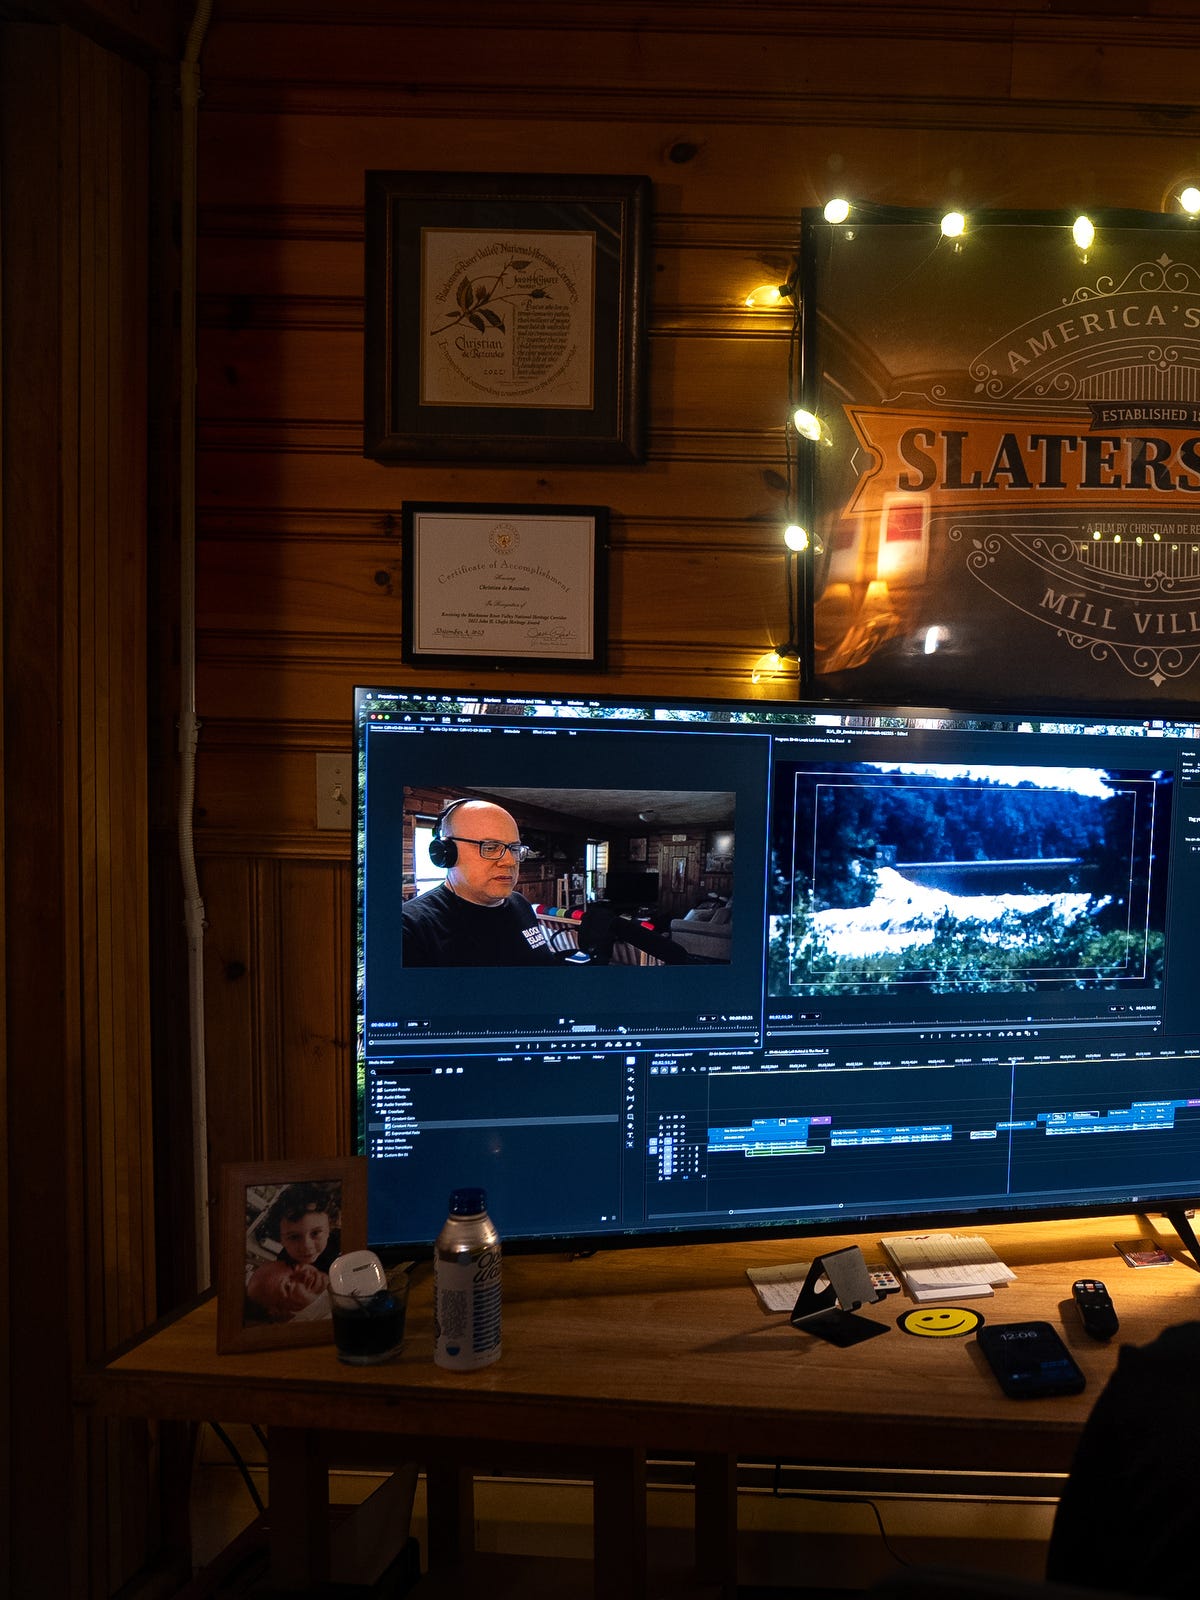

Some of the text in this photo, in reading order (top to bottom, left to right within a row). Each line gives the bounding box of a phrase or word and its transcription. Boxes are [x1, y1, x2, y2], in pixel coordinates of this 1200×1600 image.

[455, 335, 503, 351] Christian
[1006, 303, 1200, 374] AMERICA'S
[1102, 408, 1187, 422] ESTABLISHED
[1095, 523, 1115, 535] FILM
[1116, 524, 1128, 534] BY
[1129, 524, 1175, 535] CHRISTIAN
[1177, 525, 1188, 535] DE
[438, 560, 570, 593] Certificate of Accomplishment
[1039, 587, 1117, 630] MILL
[1001, 1331, 1038, 1341] 12:06
